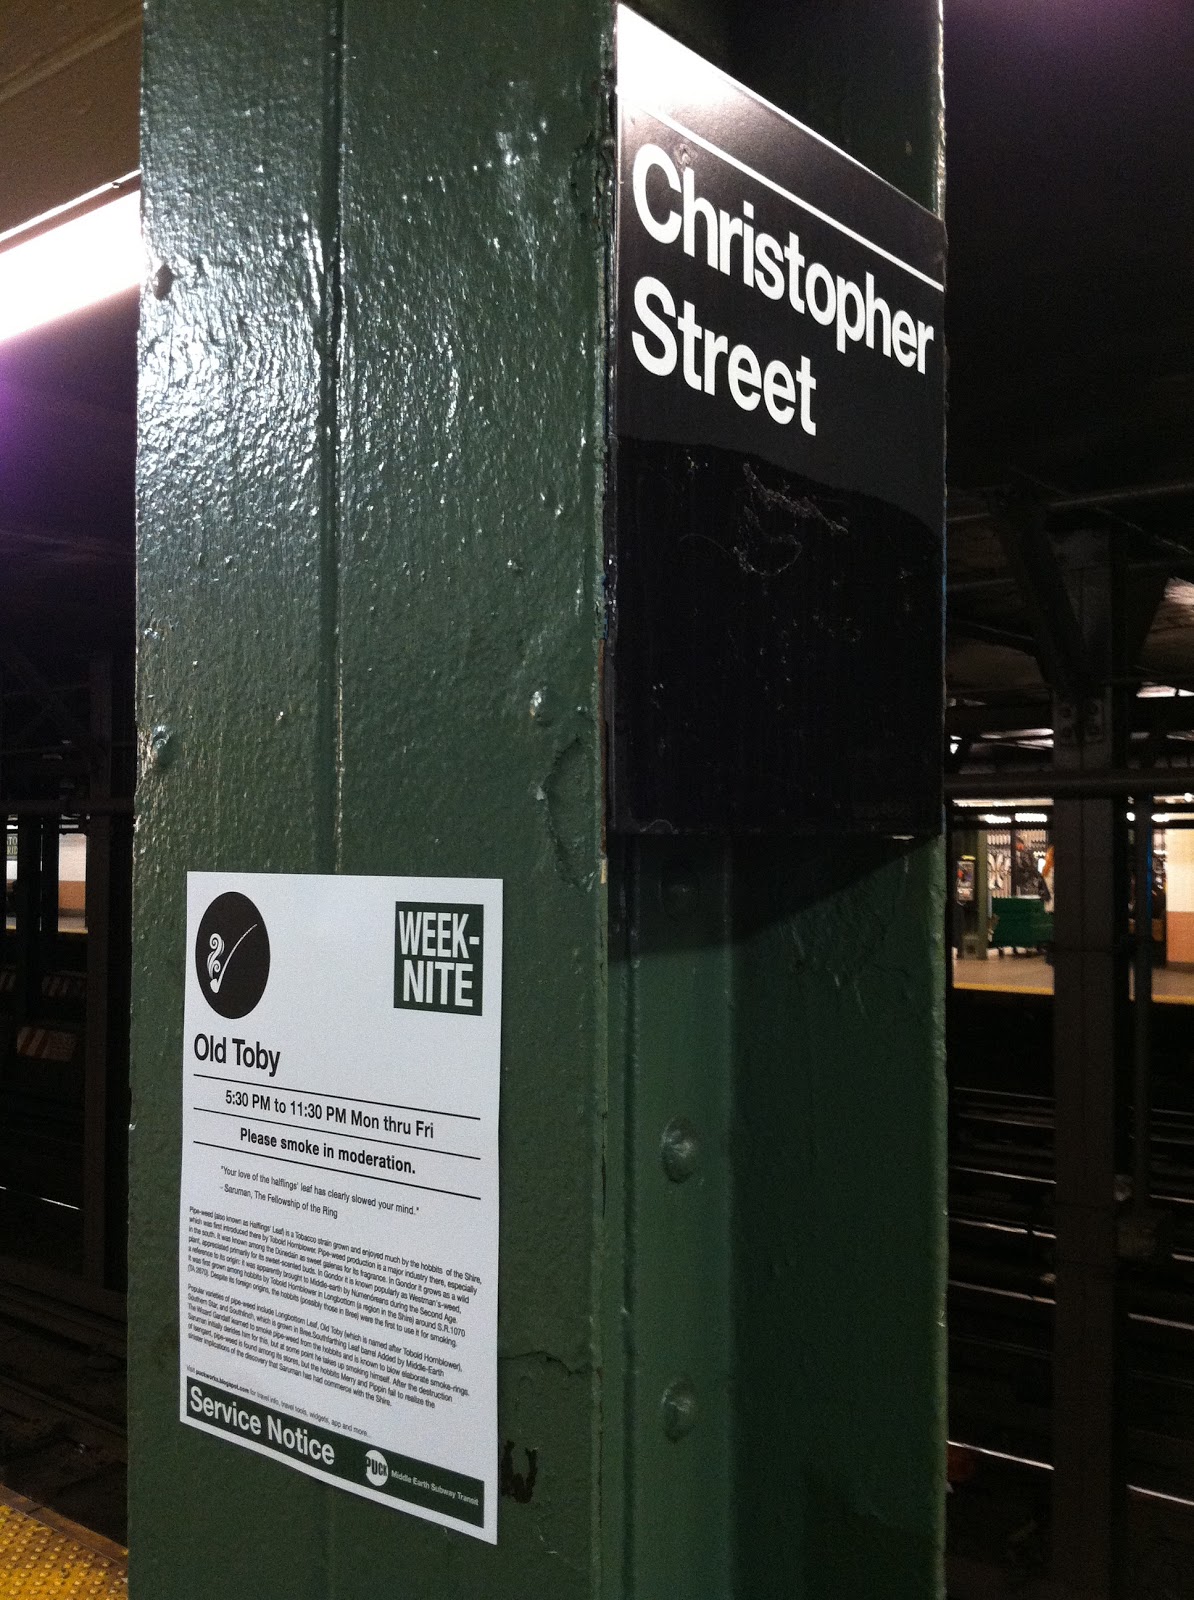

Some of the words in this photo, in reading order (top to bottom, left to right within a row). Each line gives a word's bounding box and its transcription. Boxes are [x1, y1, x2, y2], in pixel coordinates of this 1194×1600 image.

[633, 144, 934, 374] Christopher
[632, 276, 816, 436] Street
[398, 911, 479, 958] WEEK-
[403, 960, 473, 1007] NITE
[194, 1034, 226, 1063] Old
[232, 1038, 280, 1077] Toby
[225, 1089, 248, 1107] 5:30
[252, 1094, 270, 1111] PM
[274, 1098, 286, 1114] to
[291, 1101, 322, 1119] 11:30
[326, 1106, 346, 1124] PM
[351, 1110, 379, 1129] Mon
[383, 1116, 410, 1134] thru
[415, 1120, 433, 1138] Fri
[240, 1127, 276, 1147] Please
[281, 1136, 319, 1155] smoke
[324, 1145, 334, 1158] in
[338, 1147, 415, 1174] moderation.
[221, 1166, 236, 1177] "Your
[238, 1169, 250, 1180] love
[252, 1173, 258, 1181] of
[260, 1174, 269, 1183] the
[271, 1175, 299, 1192] halflings'
[301, 1182, 312, 1194] leaf
[314, 1185, 326, 1196] has
[328, 1188, 350, 1204] clearly
[352, 1193, 376, 1208] slowed
[378, 1199, 394, 1211] your
[396, 1201, 419, 1215] mind."
[224, 1183, 252, 1198] Saruman,
[255, 1192, 266, 1201] The
[267, 1193, 300, 1209] Fellowship
[310, 1204, 320, 1213] the
[323, 1206, 338, 1219] Ring
[190, 1385, 262, 1435] Service
[267, 1415, 334, 1465] Notice
[391, 1470, 412, 1484] Middle
[413, 1476, 429, 1490] Earth
[431, 1483, 455, 1498] Subway
[457, 1490, 478, 1506] Transit
